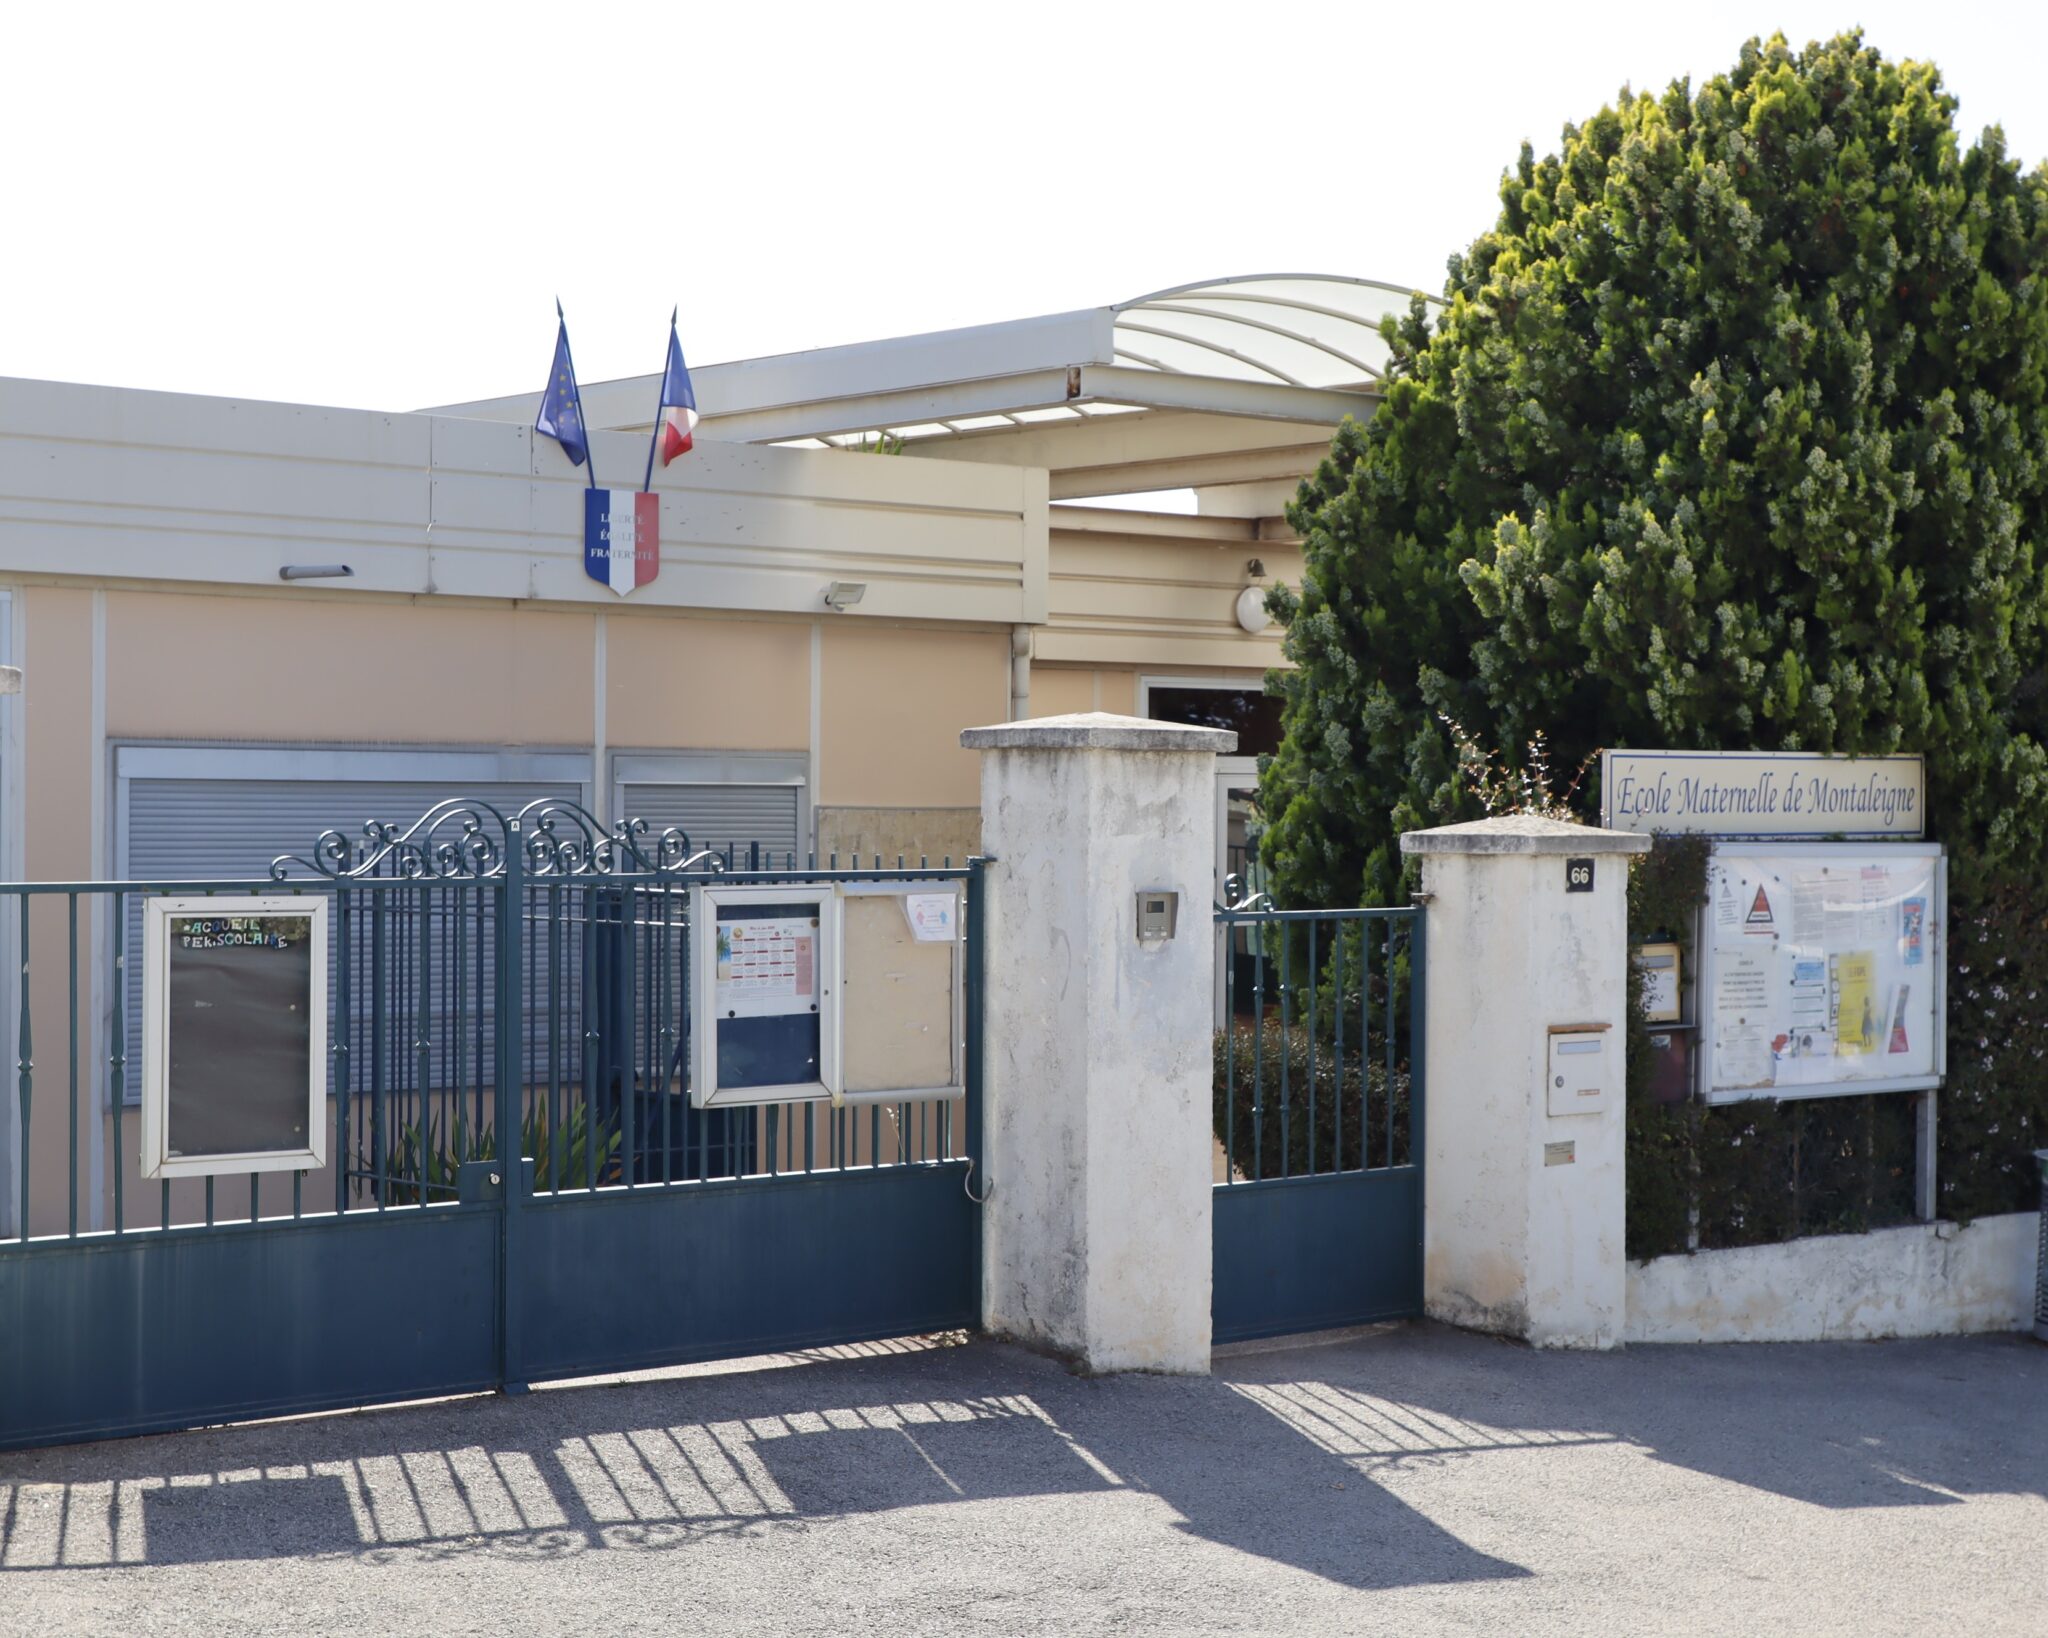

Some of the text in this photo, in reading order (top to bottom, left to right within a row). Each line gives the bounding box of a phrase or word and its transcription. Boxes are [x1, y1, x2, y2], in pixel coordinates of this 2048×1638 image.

[1616, 764, 1916, 826] École Maternelle de Montaleigne
[1571, 867, 1590, 885] 66
